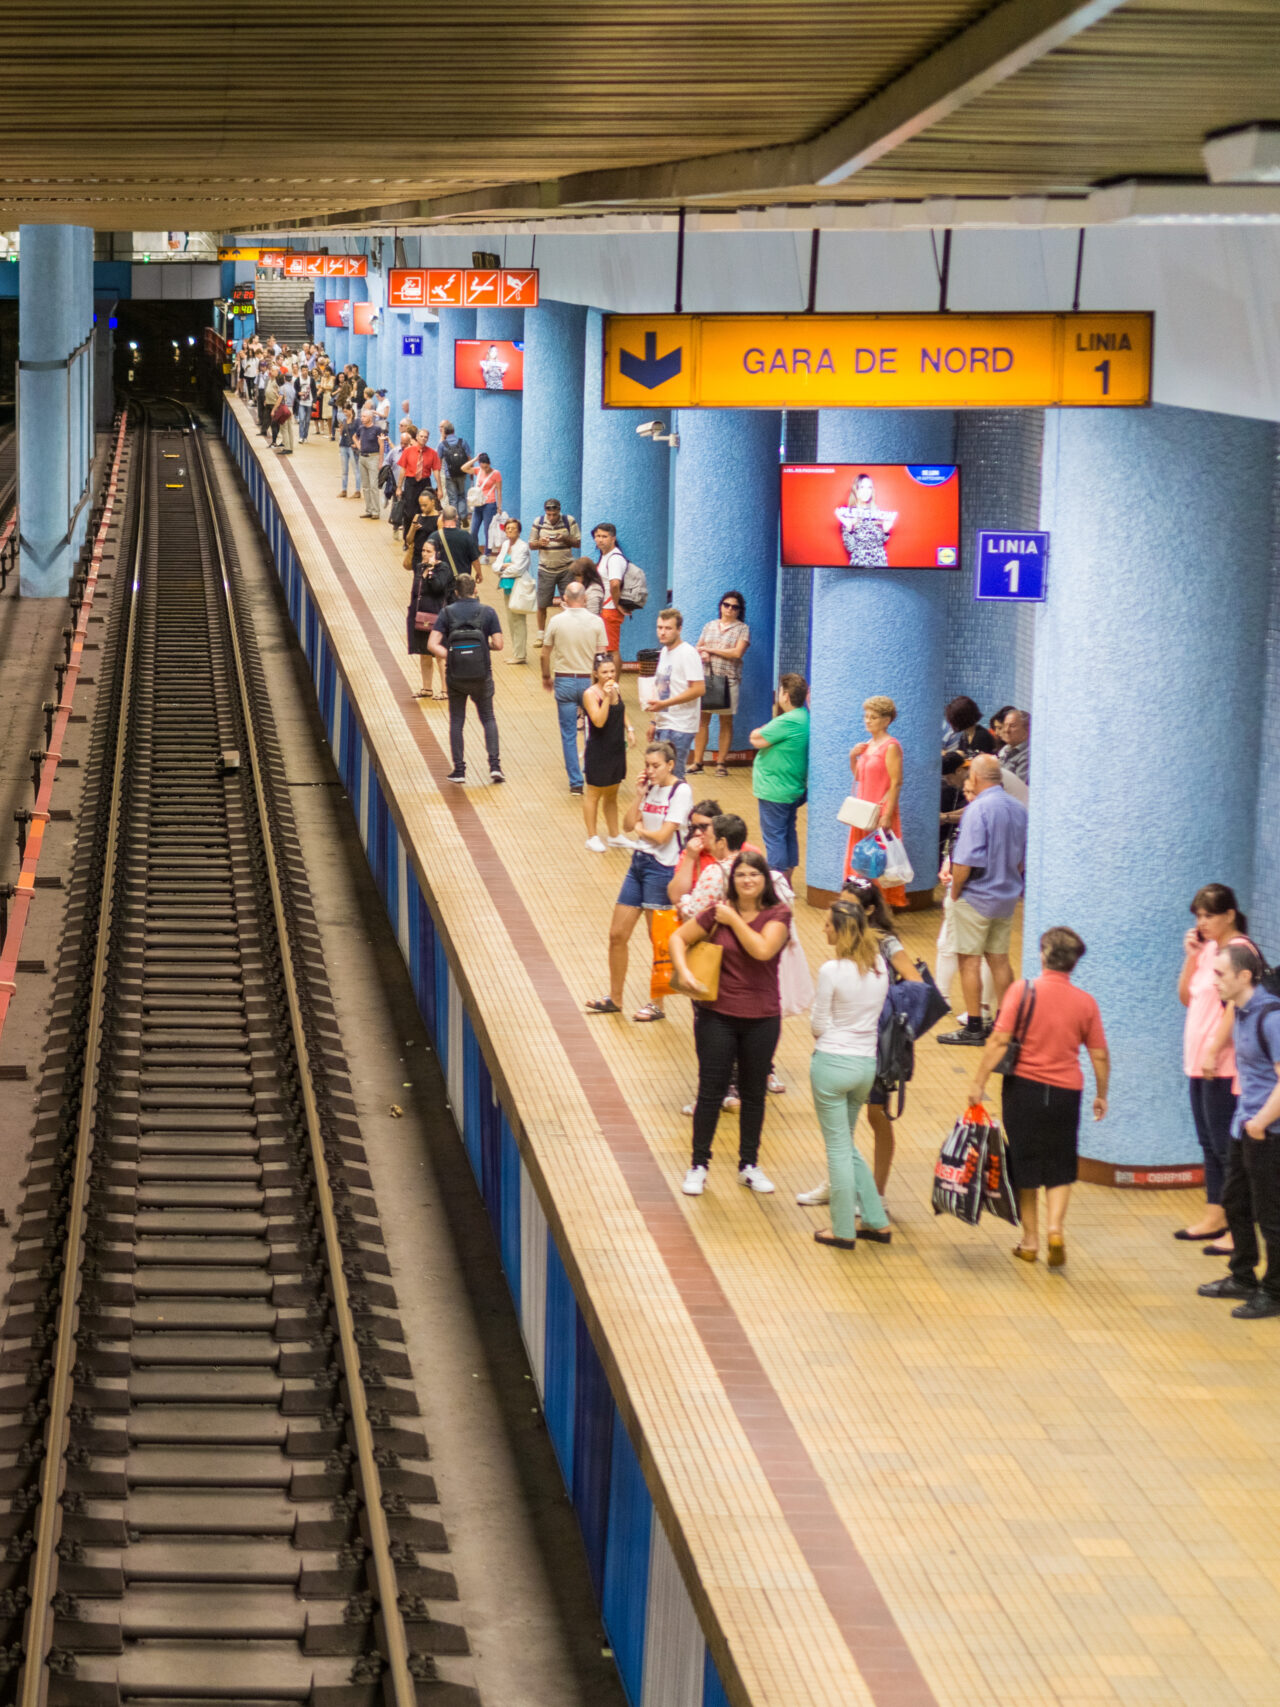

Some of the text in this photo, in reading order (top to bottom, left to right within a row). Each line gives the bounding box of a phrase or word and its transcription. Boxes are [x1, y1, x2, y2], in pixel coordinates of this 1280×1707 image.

[410, 344, 415, 354] 1
[1076, 332, 1132, 351] LINIA
[742, 346, 1015, 375] GARA DE NORD
[1094, 359, 1110, 395] 1
[987, 539, 1039, 554] LINIA
[1004, 559, 1020, 593] 1
